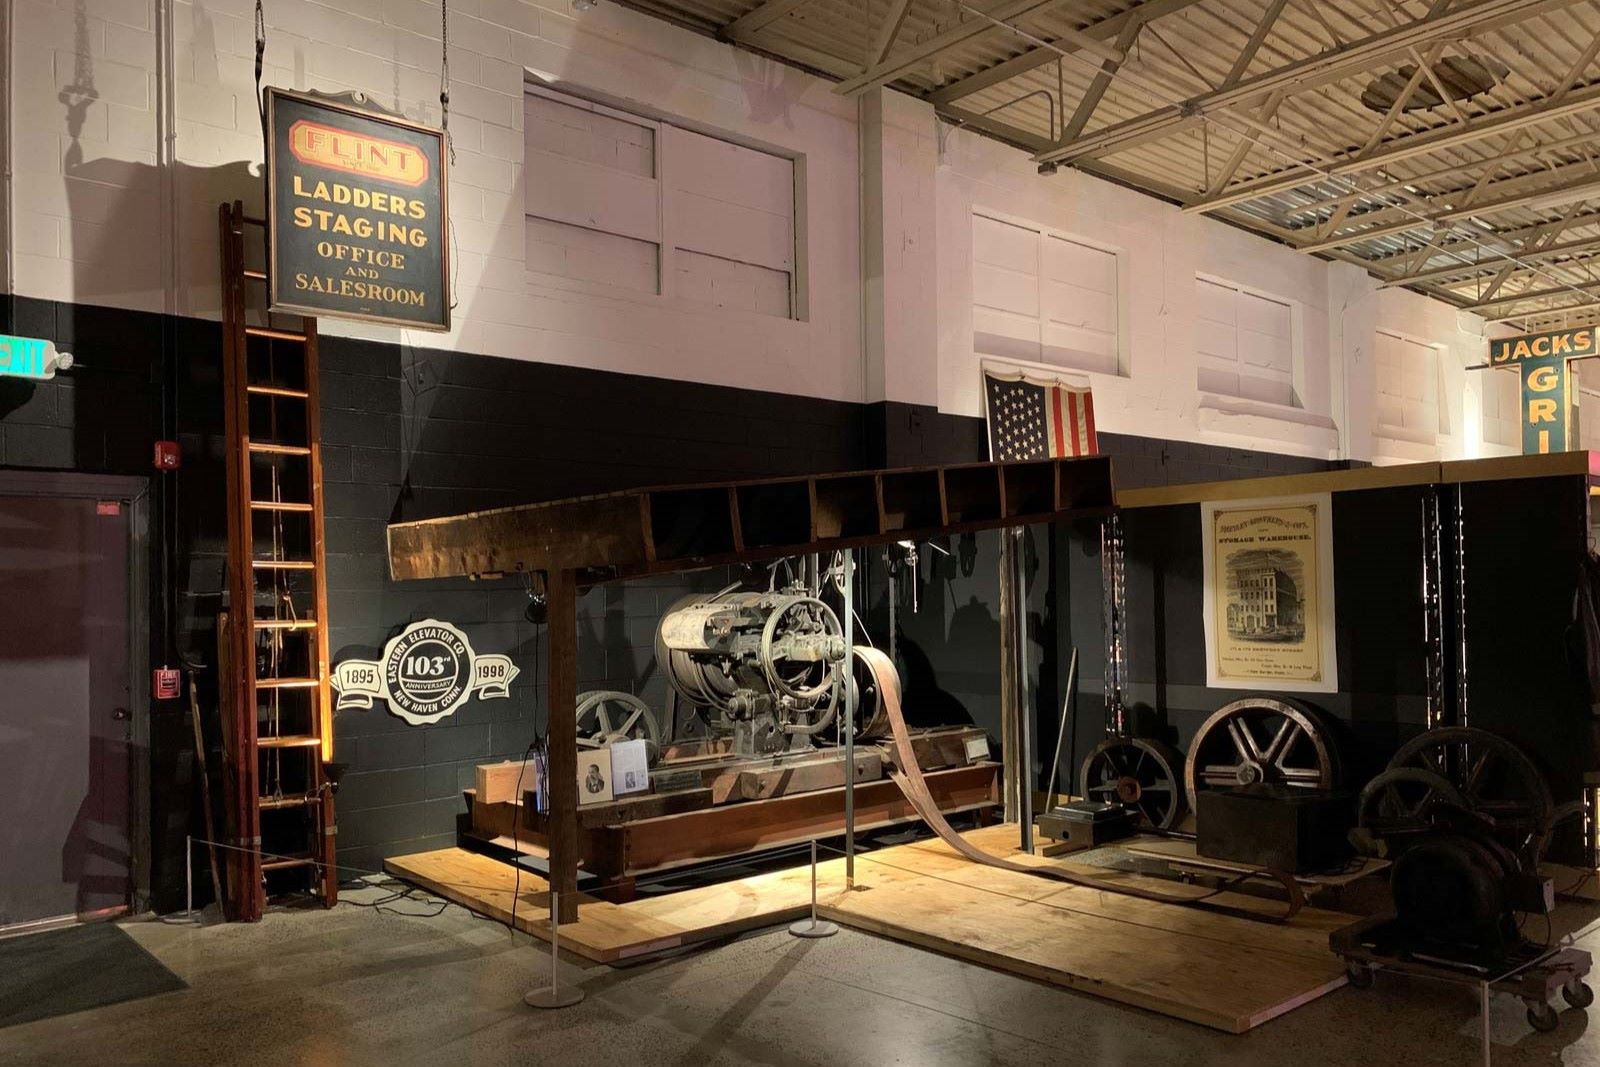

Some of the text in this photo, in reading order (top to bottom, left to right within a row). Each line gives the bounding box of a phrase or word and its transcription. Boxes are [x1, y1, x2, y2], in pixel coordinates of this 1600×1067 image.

[305, 128, 412, 172] FLINT
[293, 176, 426, 219] LADDERS
[294, 207, 427, 247] STAGING
[317, 241, 405, 270] OFFICE
[345, 266, 379, 280] AND
[295, 273, 425, 307] SALESROOM
[1494, 331, 1592, 362] JACKS
[388, 641, 408, 684] EASTERN
[408, 628, 455, 644] ELEVATOR
[345, 669, 374, 684] 1895
[405, 680, 451, 690] ANNIVERSARY
[478, 665, 505, 678] 1998
[393, 690, 411, 708] NEW
[411, 703, 438, 713] HAVEN
